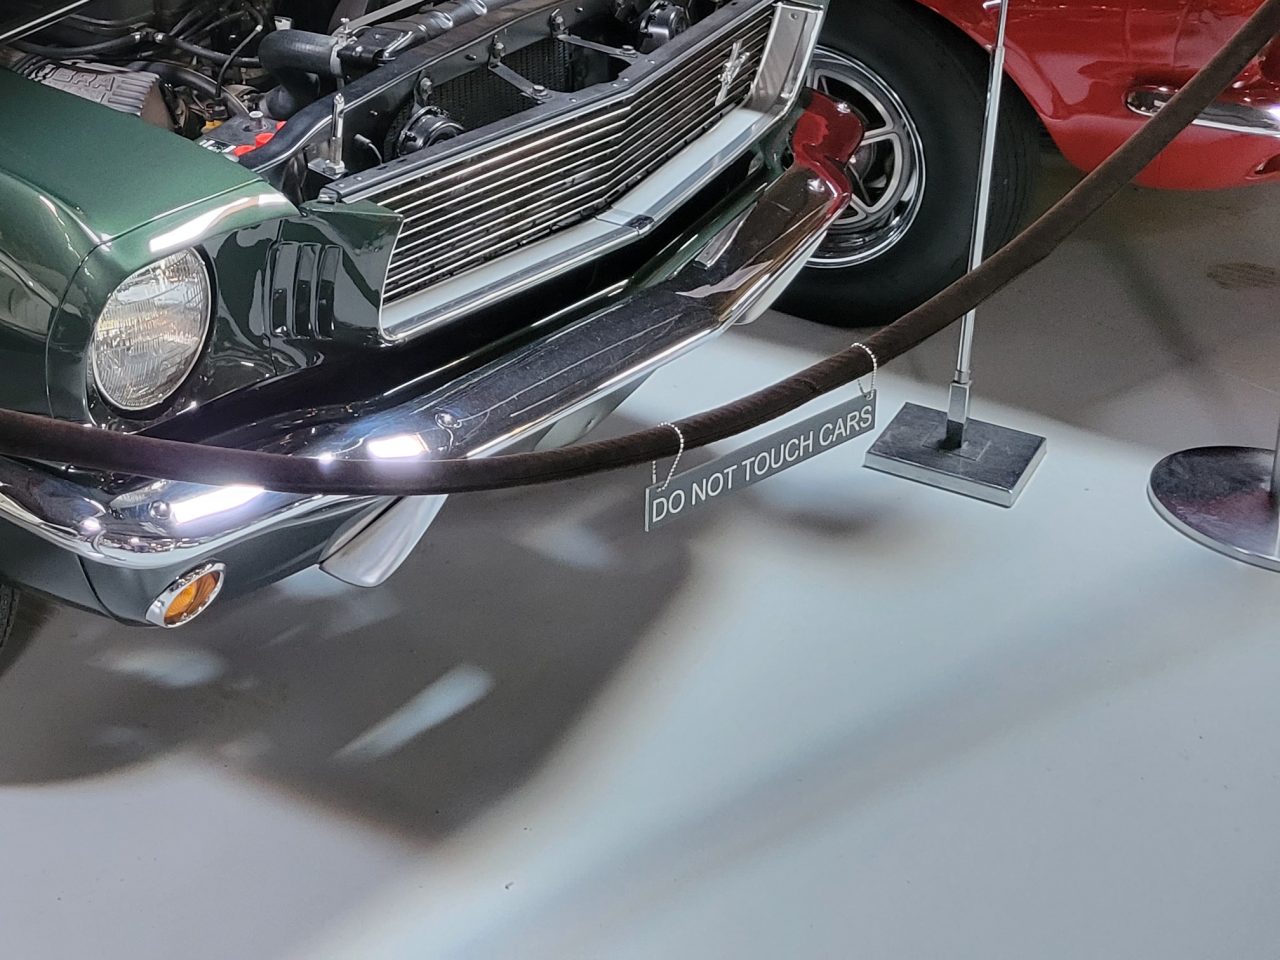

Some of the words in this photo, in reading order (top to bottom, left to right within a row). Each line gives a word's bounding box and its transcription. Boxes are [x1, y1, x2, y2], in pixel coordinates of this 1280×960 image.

[651, 489, 686, 524] DO
[691, 464, 738, 506] NOT
[741, 429, 814, 482] TOUCH
[819, 404, 873, 448] CARS
